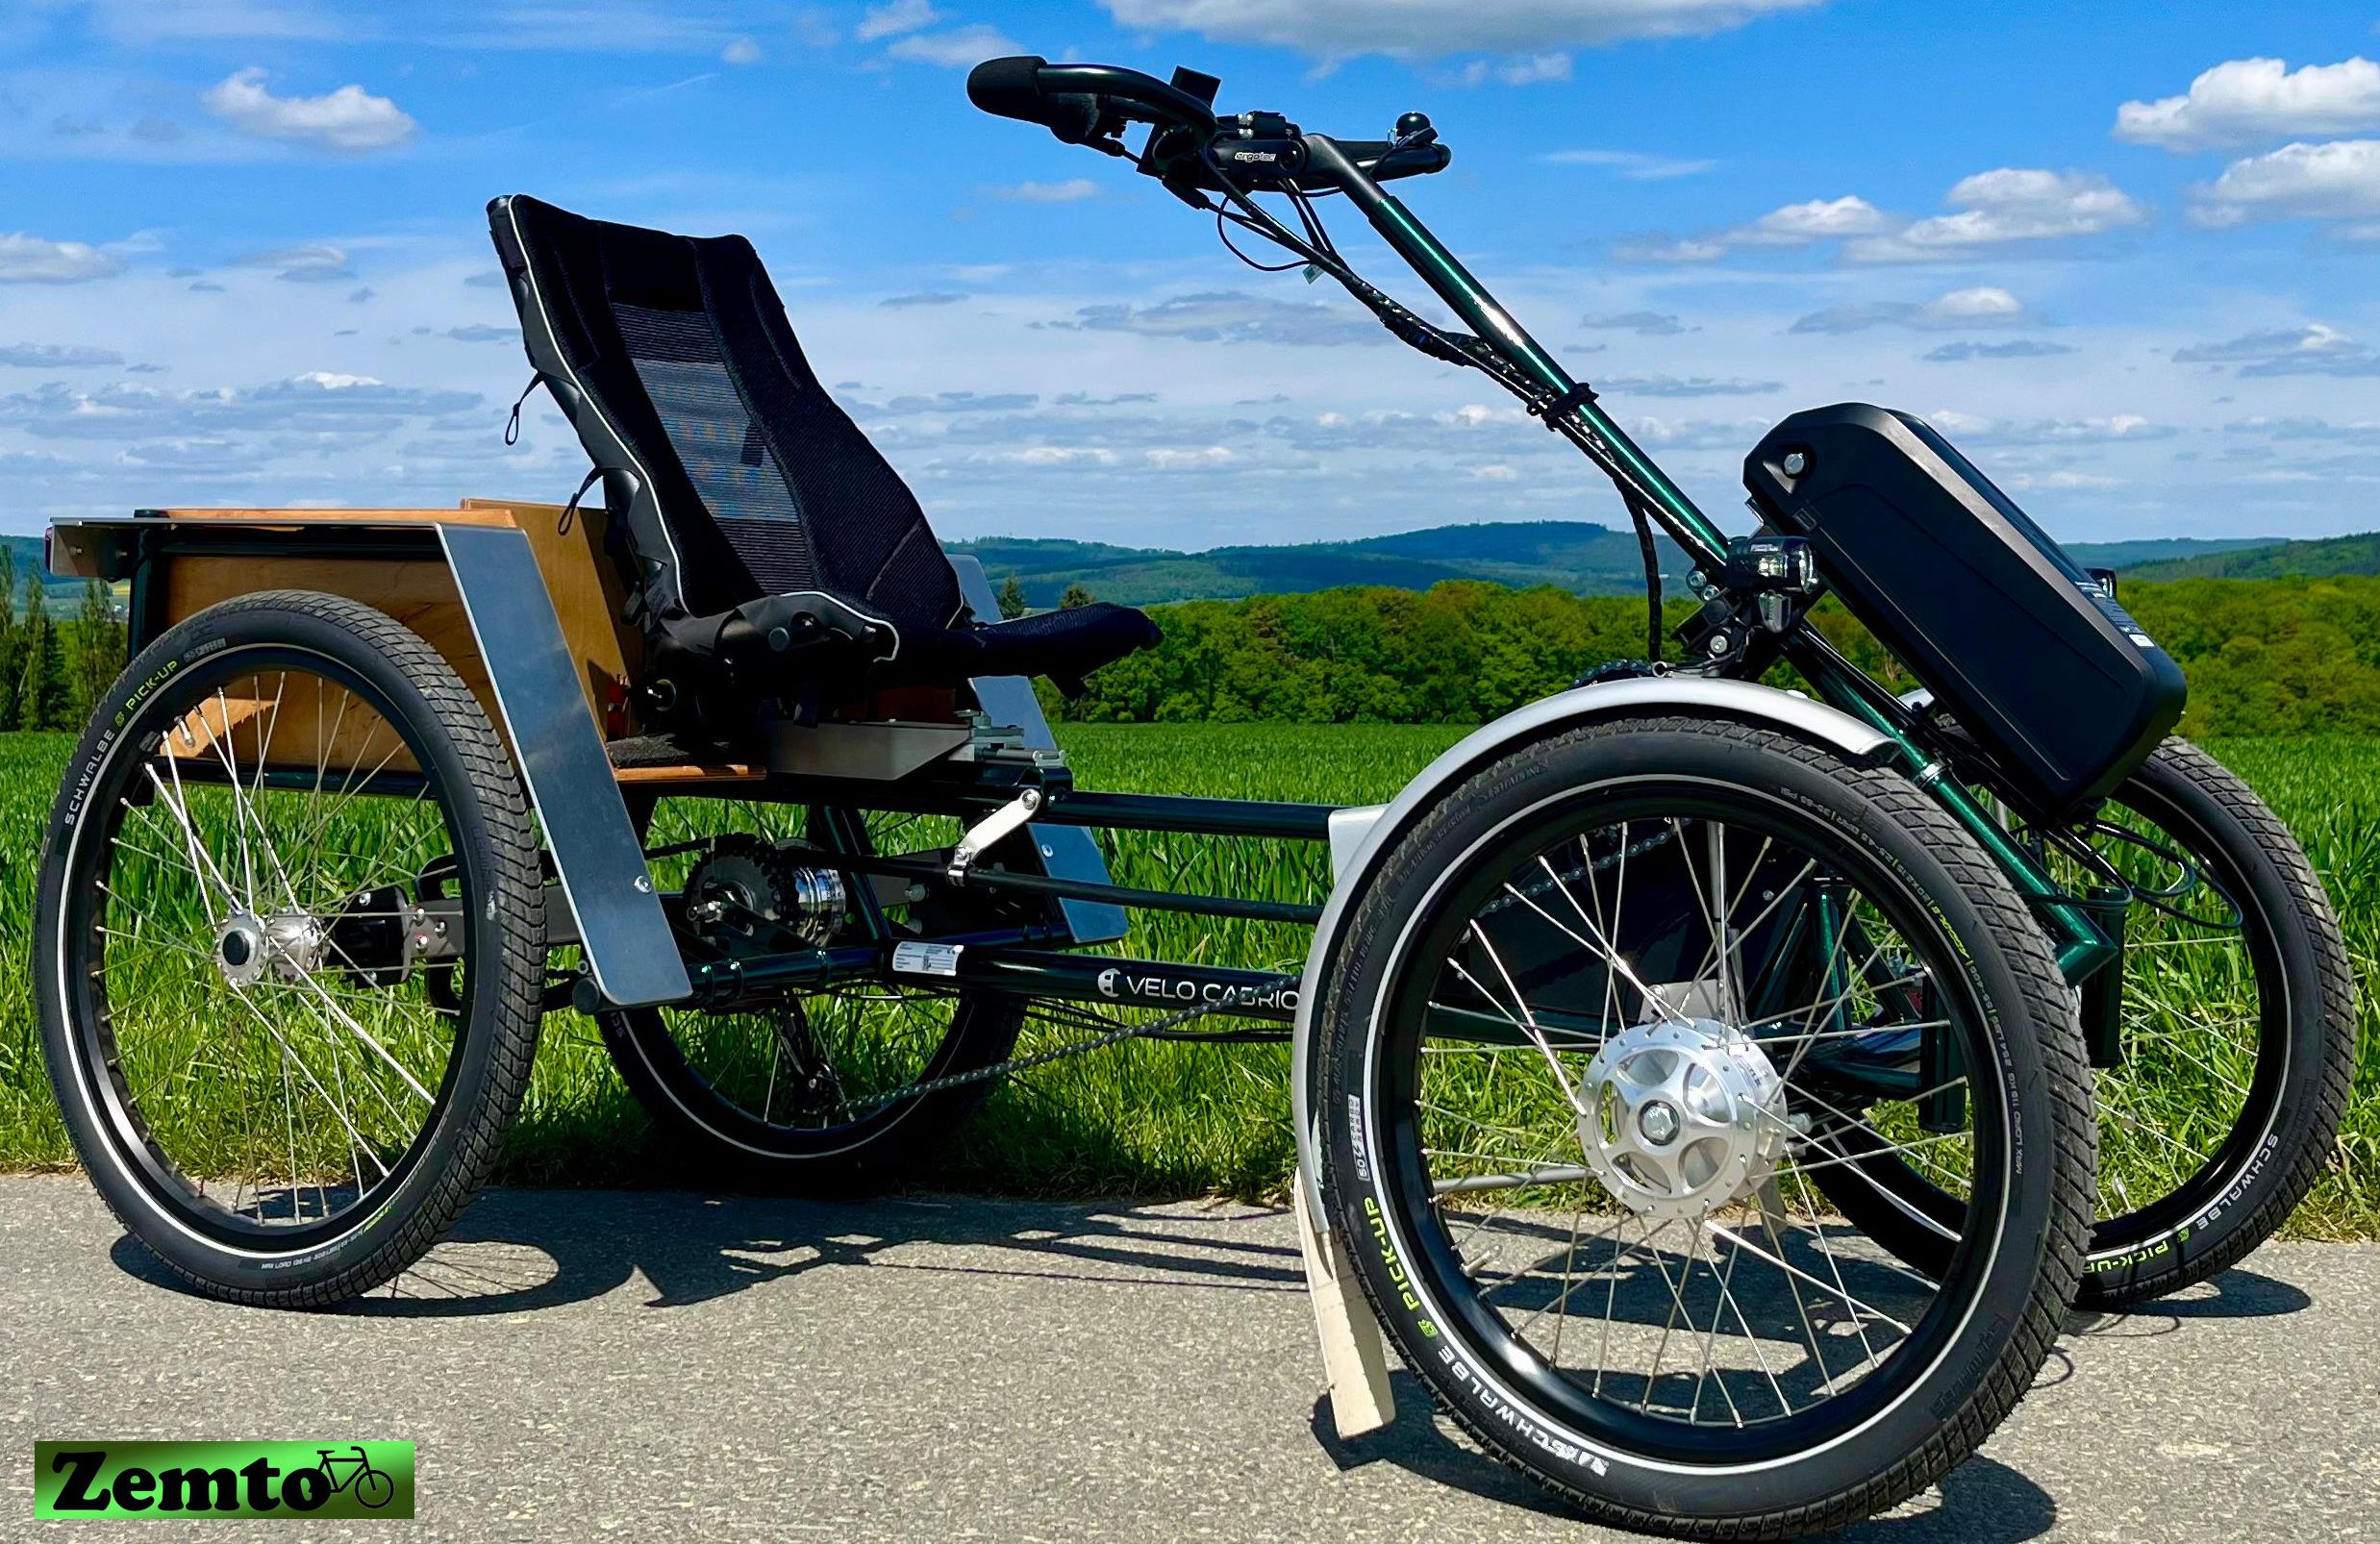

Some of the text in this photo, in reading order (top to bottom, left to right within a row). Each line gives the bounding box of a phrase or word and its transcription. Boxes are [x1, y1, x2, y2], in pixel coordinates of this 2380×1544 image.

[64, 660, 178, 826] SCHWALBE PICK-UP
[1126, 975, 1300, 1010] VELO CABRIO
[2195, 1133, 2279, 1231] SCHWALBE
[1364, 1196, 1568, 1458] SCHWALBE PICK-UP
